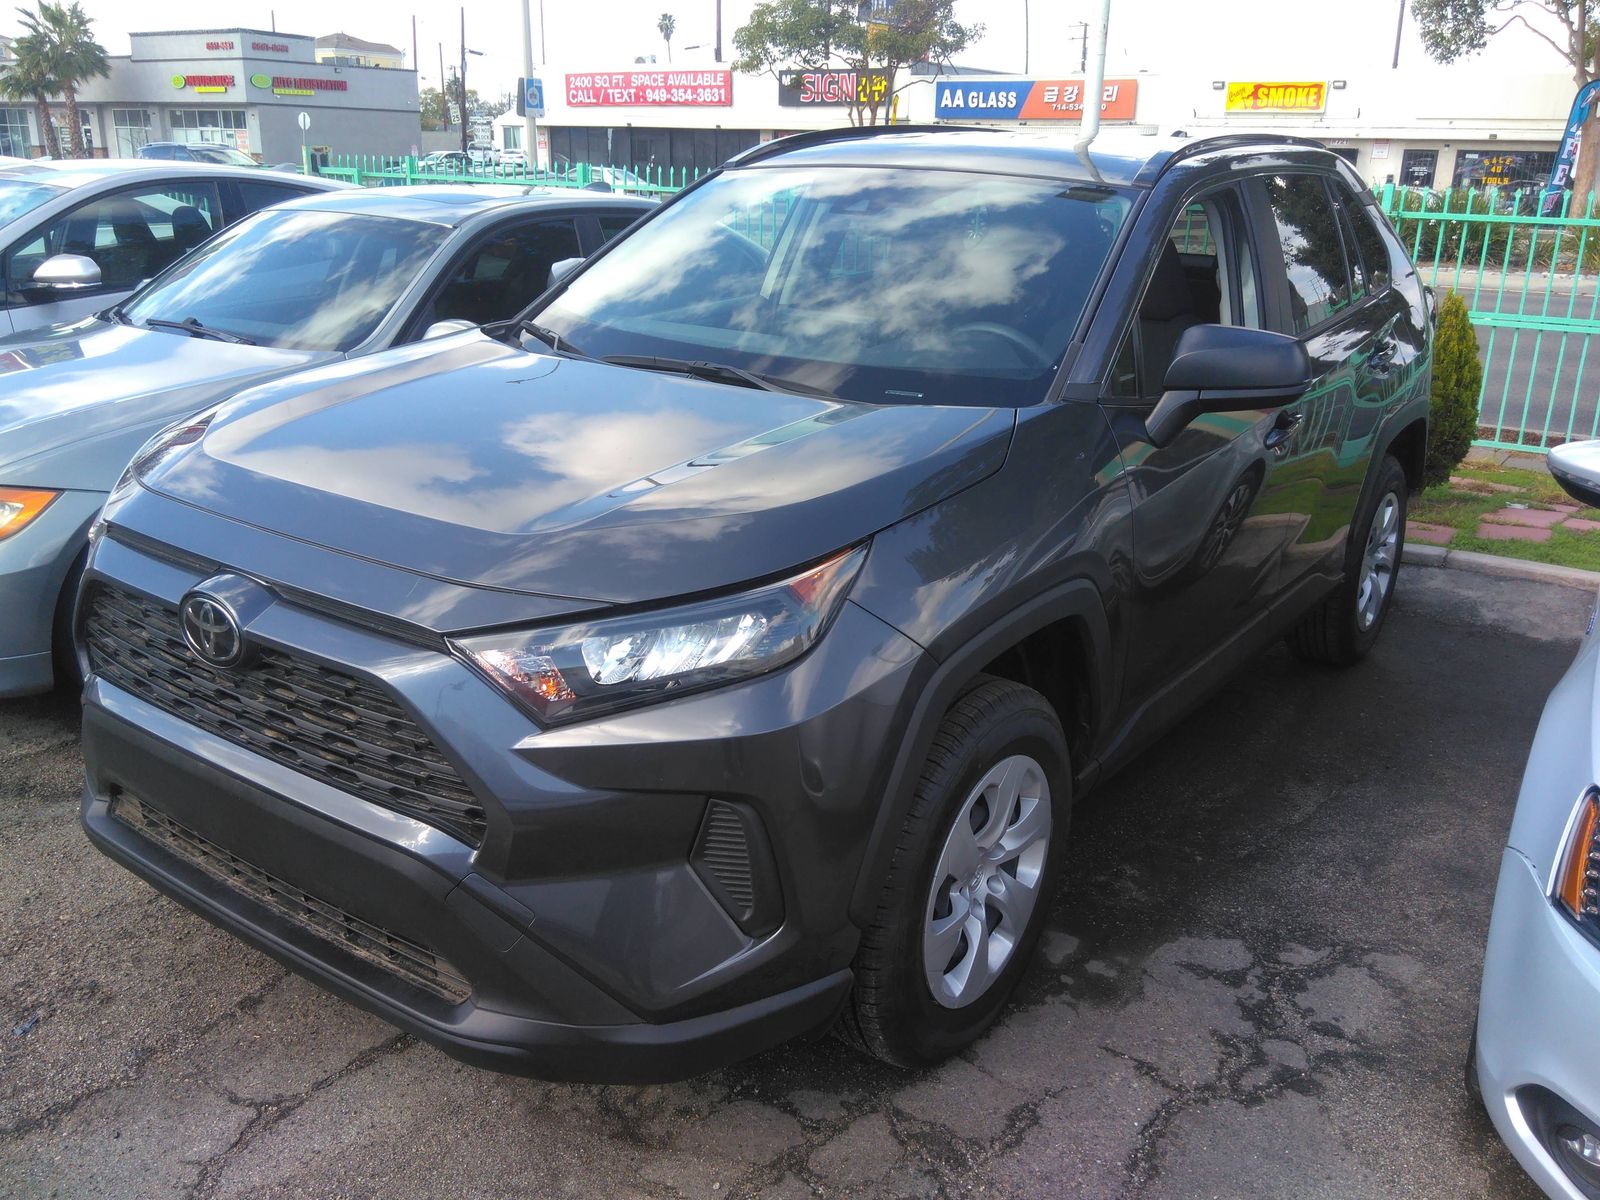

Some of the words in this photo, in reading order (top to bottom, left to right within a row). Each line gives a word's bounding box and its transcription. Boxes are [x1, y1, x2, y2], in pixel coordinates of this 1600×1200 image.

[294, 78, 348, 91] REGISTRATION
[569, 77, 592, 88] 2400
[612, 75, 625, 87] FT.
[631, 74, 665, 87] SPACE
[667, 73, 725, 86] AVAILABLE
[800, 73, 857, 102] SIGN
[569, 89, 597, 103] CALL
[607, 89, 636, 103] TEXT
[646, 88, 726, 102] 949-354-3631
[940, 89, 965, 108] AA
[968, 91, 1017, 108] GLASS
[1043, 85, 1119, 103] 금강리
[1256, 87, 1319, 108] SMOKE
[452, 114, 461, 122] 25
[1483, 156, 1513, 166] SALE
[1481, 176, 1510, 185] TOOLS
